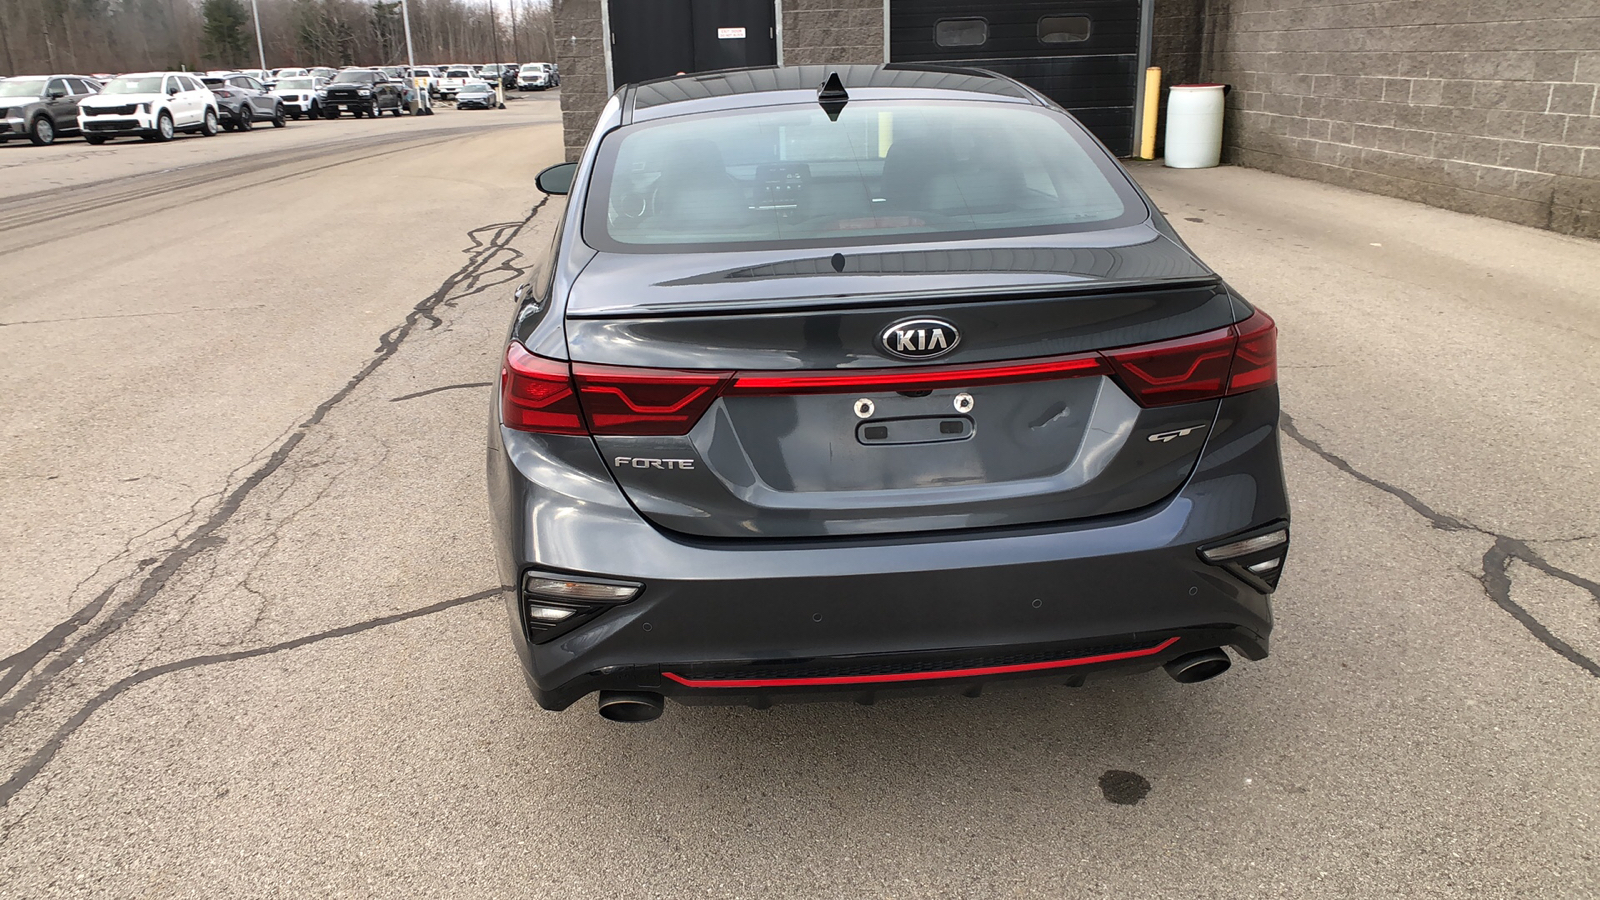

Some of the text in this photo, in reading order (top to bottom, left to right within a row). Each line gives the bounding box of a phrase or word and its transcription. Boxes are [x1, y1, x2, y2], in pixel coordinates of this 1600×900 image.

[895, 328, 948, 351] KIA
[1148, 424, 1206, 443] GT
[614, 456, 695, 470] FORTE
